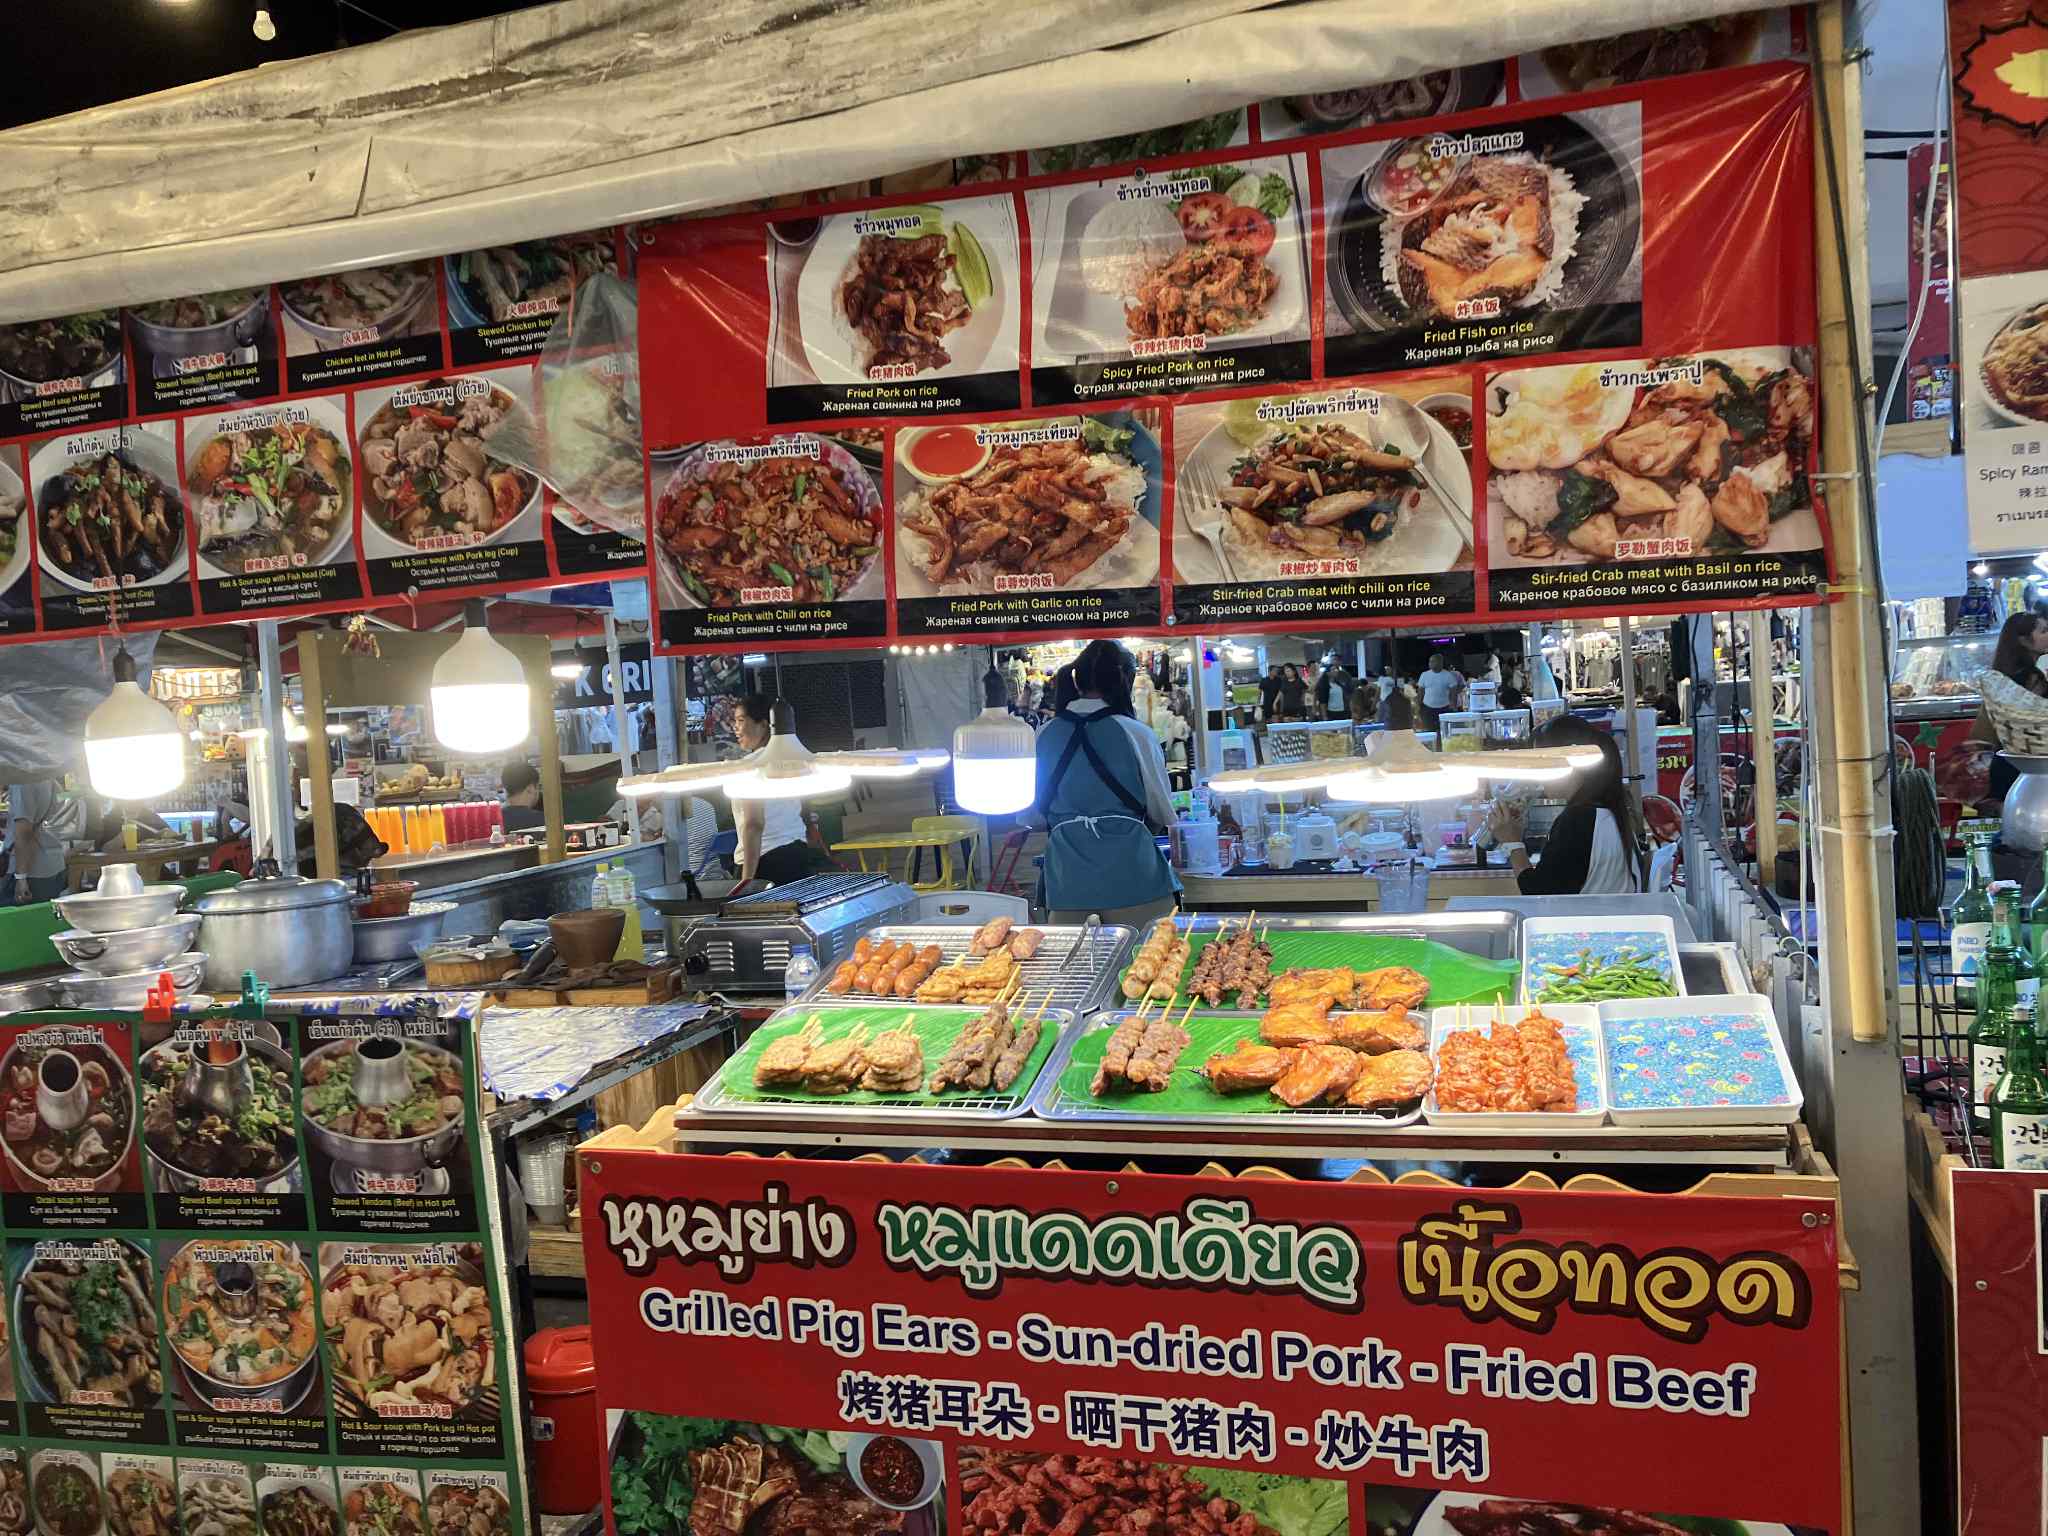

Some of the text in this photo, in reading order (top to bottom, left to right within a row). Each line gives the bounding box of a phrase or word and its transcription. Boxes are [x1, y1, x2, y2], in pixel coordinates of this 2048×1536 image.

[1117, 179, 1210, 200] ข้าวยำหมูทอด
[854, 216, 921, 236] ข้าวหมูทอด
[1424, 323, 1534, 343] Fried Fish on rice
[1405, 336, 1554, 360] Жареная рыба на рисе
[1103, 357, 1235, 380] Spicy Fried Pork on rice
[1600, 362, 1701, 386] ข้าวกะเพราปู
[847, 386, 938, 398] Fried Pork on rice
[1074, 369, 1265, 395] Острая жареная свинина на рисе
[822, 398, 961, 413] Жареная свинина на рисе
[1257, 390, 1379, 421] ข้าวปูผัดพริกขี้หนู
[976, 424, 1079, 448] ข้าวหมูกระเทียม
[706, 435, 820, 463] ข้าวหมูทอดพริกขี้หนู
[1979, 468, 2017, 482] Spicy
[1531, 561, 1781, 585] Stir-fried Crab meat with Basil on rice
[1213, 581, 1431, 601] Stir-fried Crab meat with chili on rice
[1499, 575, 1816, 603] Жареное крабовое мясо с базиликом на рисе
[951, 596, 1102, 612] Fried Pork with Garlic on rice
[1199, 597, 1446, 617] Жареное крабовое мясо с чили на рисе
[707, 613, 730, 623] Fried
[732, 612, 753, 622] Pork
[755, 611, 773, 621] with
[775, 610, 797, 620] Chili
[814, 609, 832, 619] rice
[925, 610, 1129, 627] Жареная свинина с чесноком на рисе
[694, 622, 848, 637] Жареная свинина с чили на рисе
[603, 1188, 1796, 1334] หูหมูย่าง หมูแดดเดียว เนื้อทอด
[643, 1292, 1749, 1412] Grilled Pig Ears Sun-dried Pork Fried Beef
[842, 1375, 1484, 1477] 烤猪耳朵 晒干猪肉 炒牛肉
